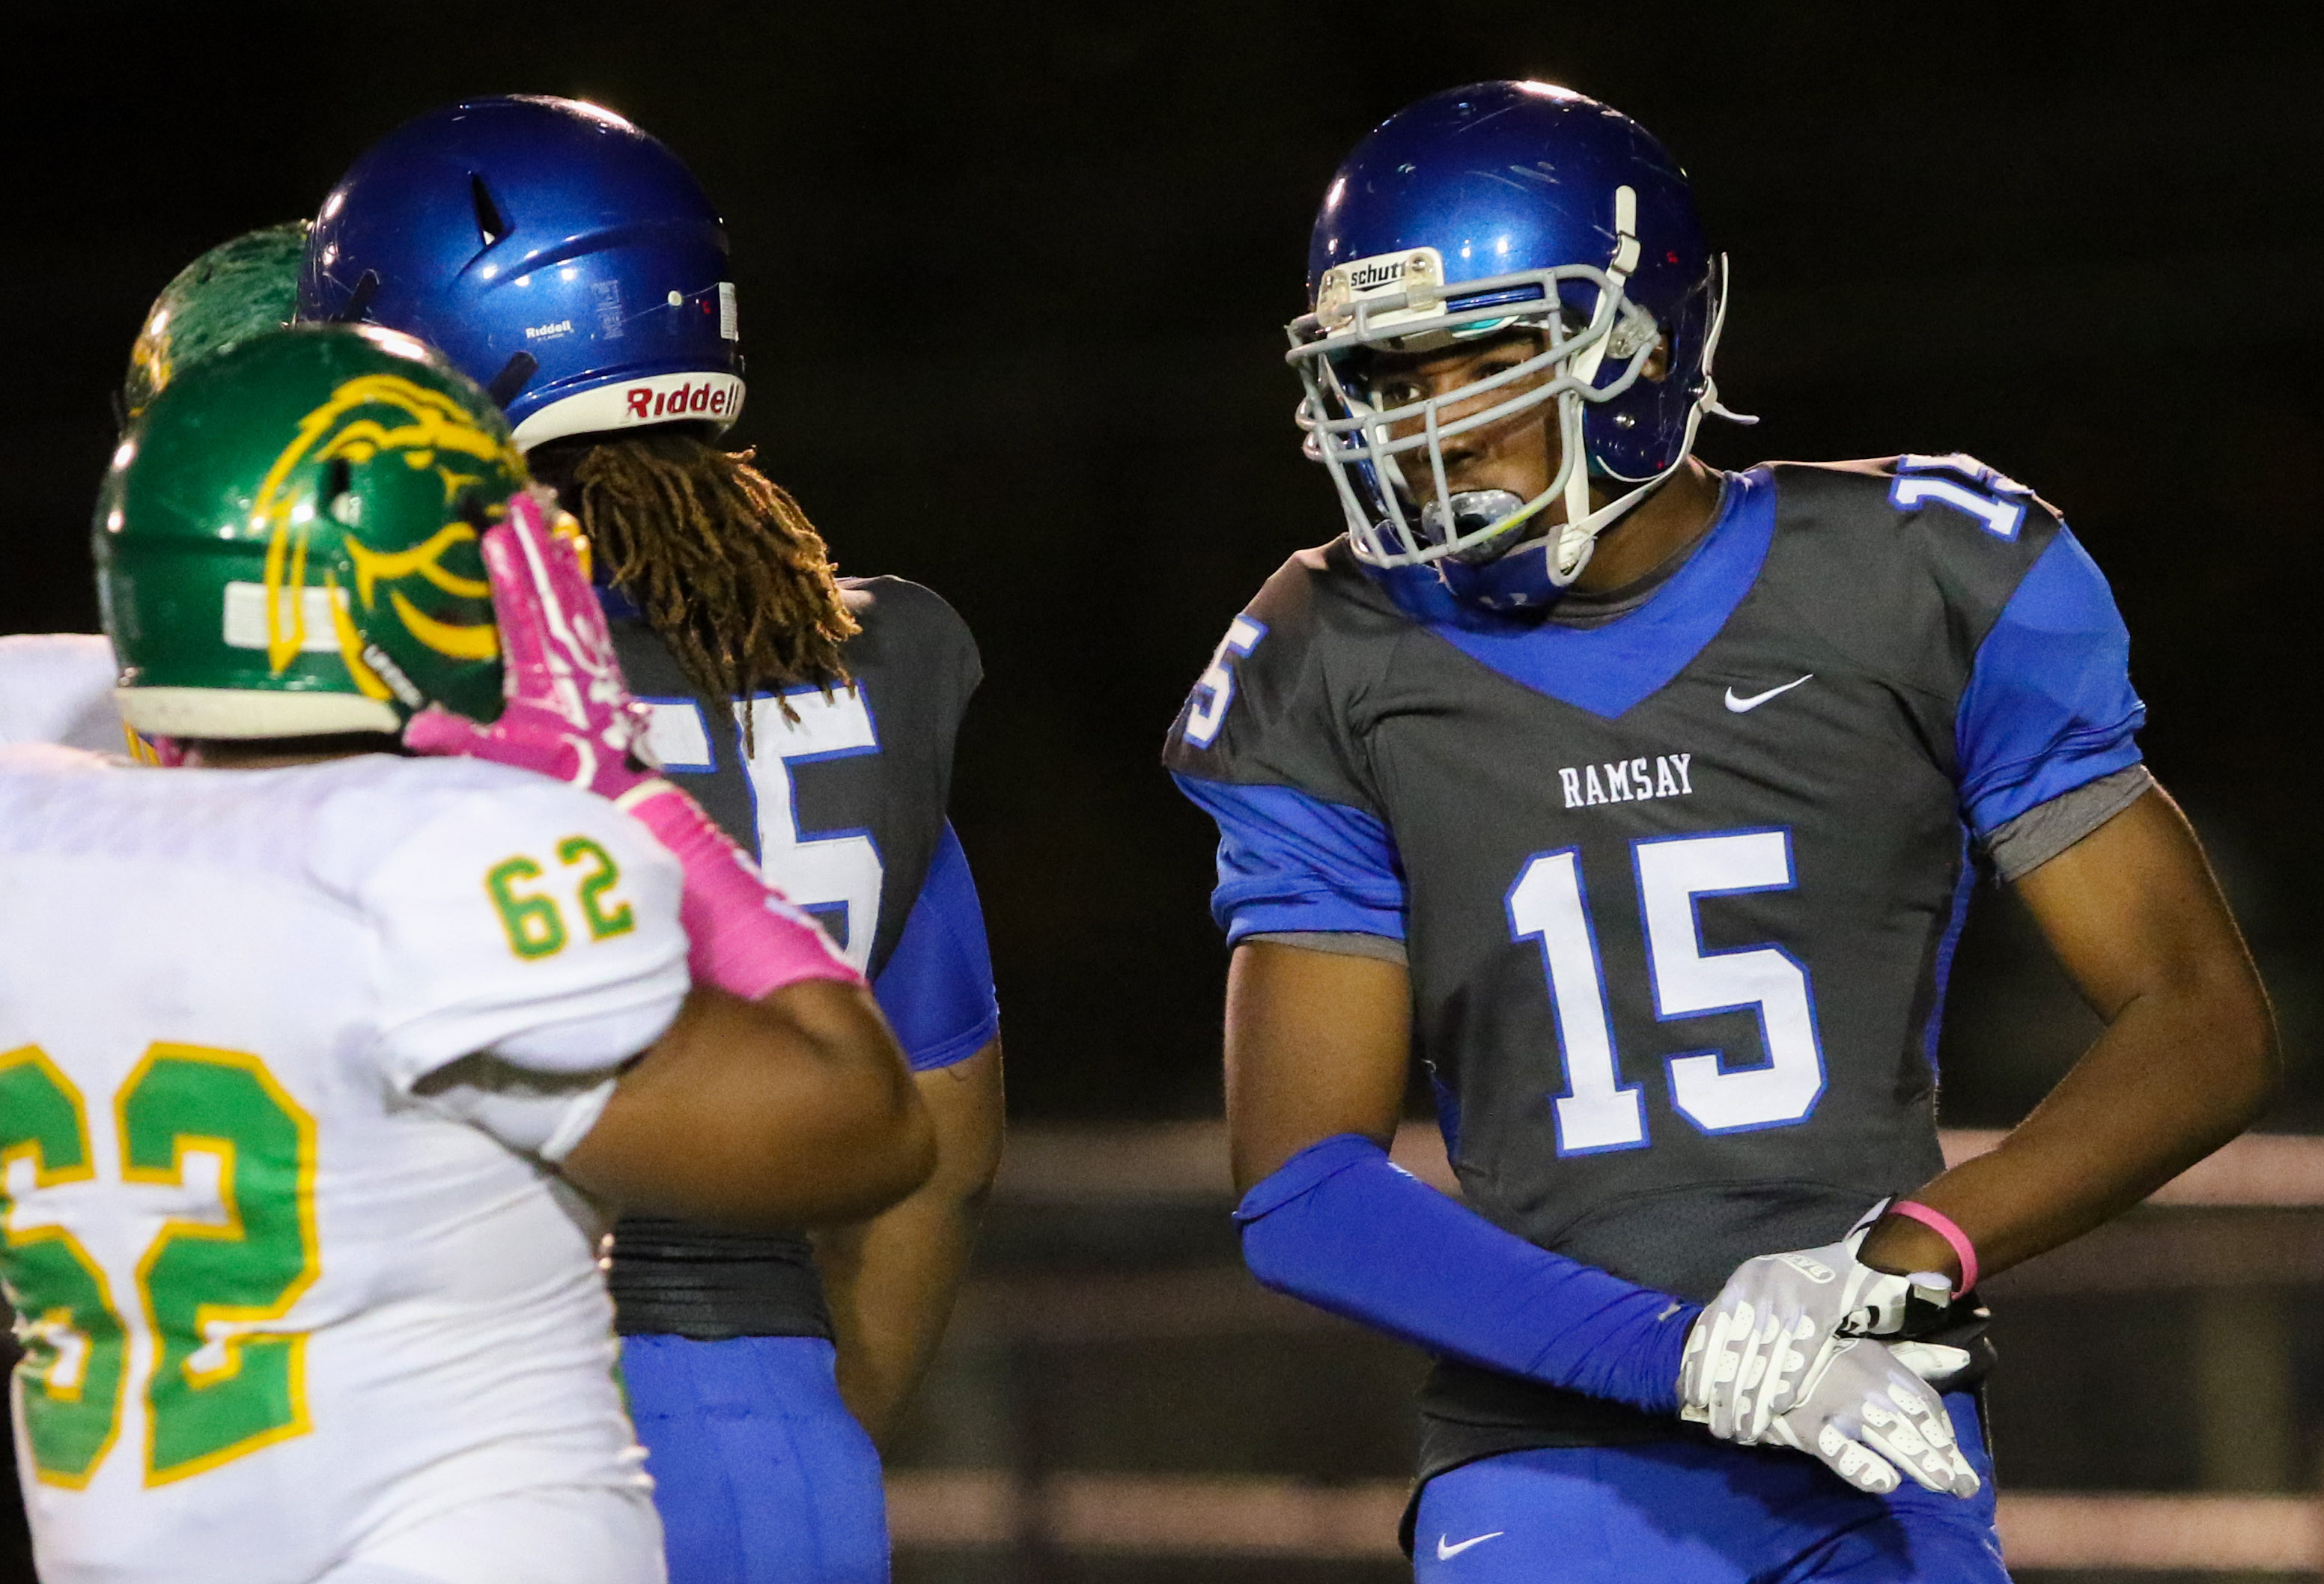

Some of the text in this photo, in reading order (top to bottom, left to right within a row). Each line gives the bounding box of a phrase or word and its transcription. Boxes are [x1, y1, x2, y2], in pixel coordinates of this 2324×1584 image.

[526, 320, 571, 339] Riddell
[626, 383, 739, 418] Riddell
[1558, 752, 1693, 808] RAMSAY
[484, 834, 635, 961] 62
[1503, 824, 1828, 1158] 15
